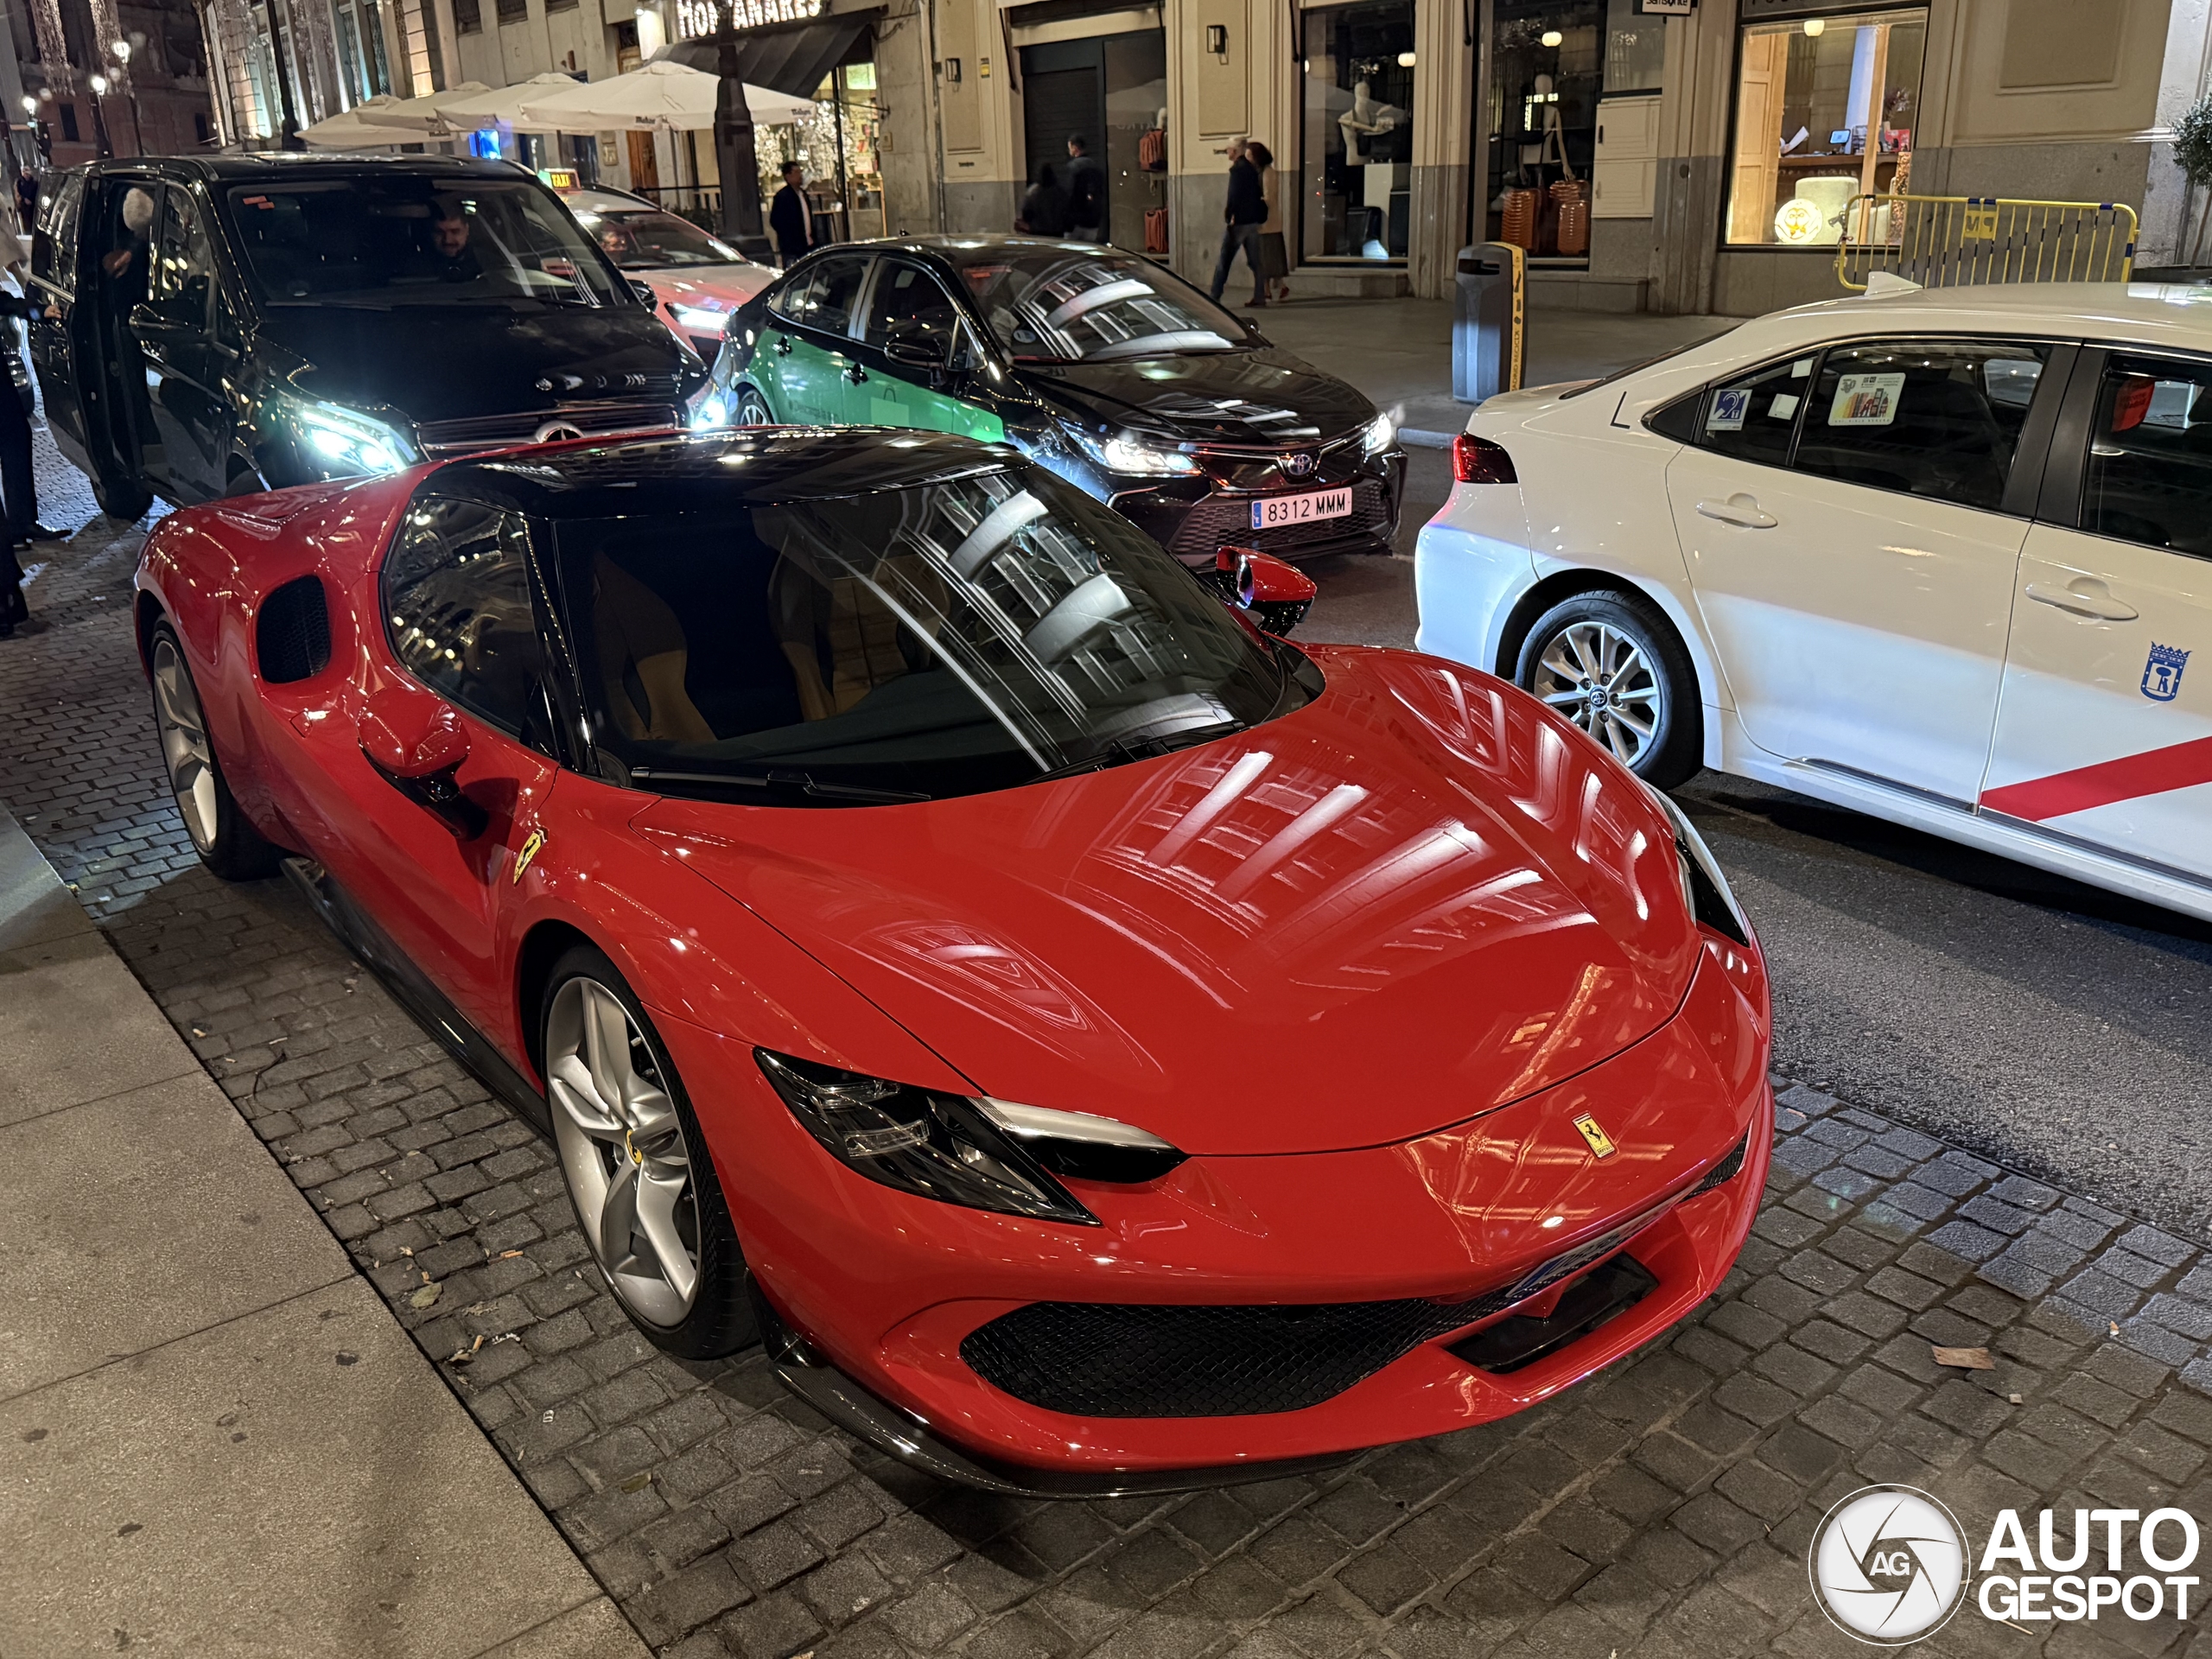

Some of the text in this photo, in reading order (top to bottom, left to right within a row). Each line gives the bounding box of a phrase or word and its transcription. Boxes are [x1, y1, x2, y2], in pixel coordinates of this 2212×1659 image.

[551, 175, 570, 188] TAXI
[1268, 499, 1309, 522] 8312
[1316, 493, 1345, 516] MMM
